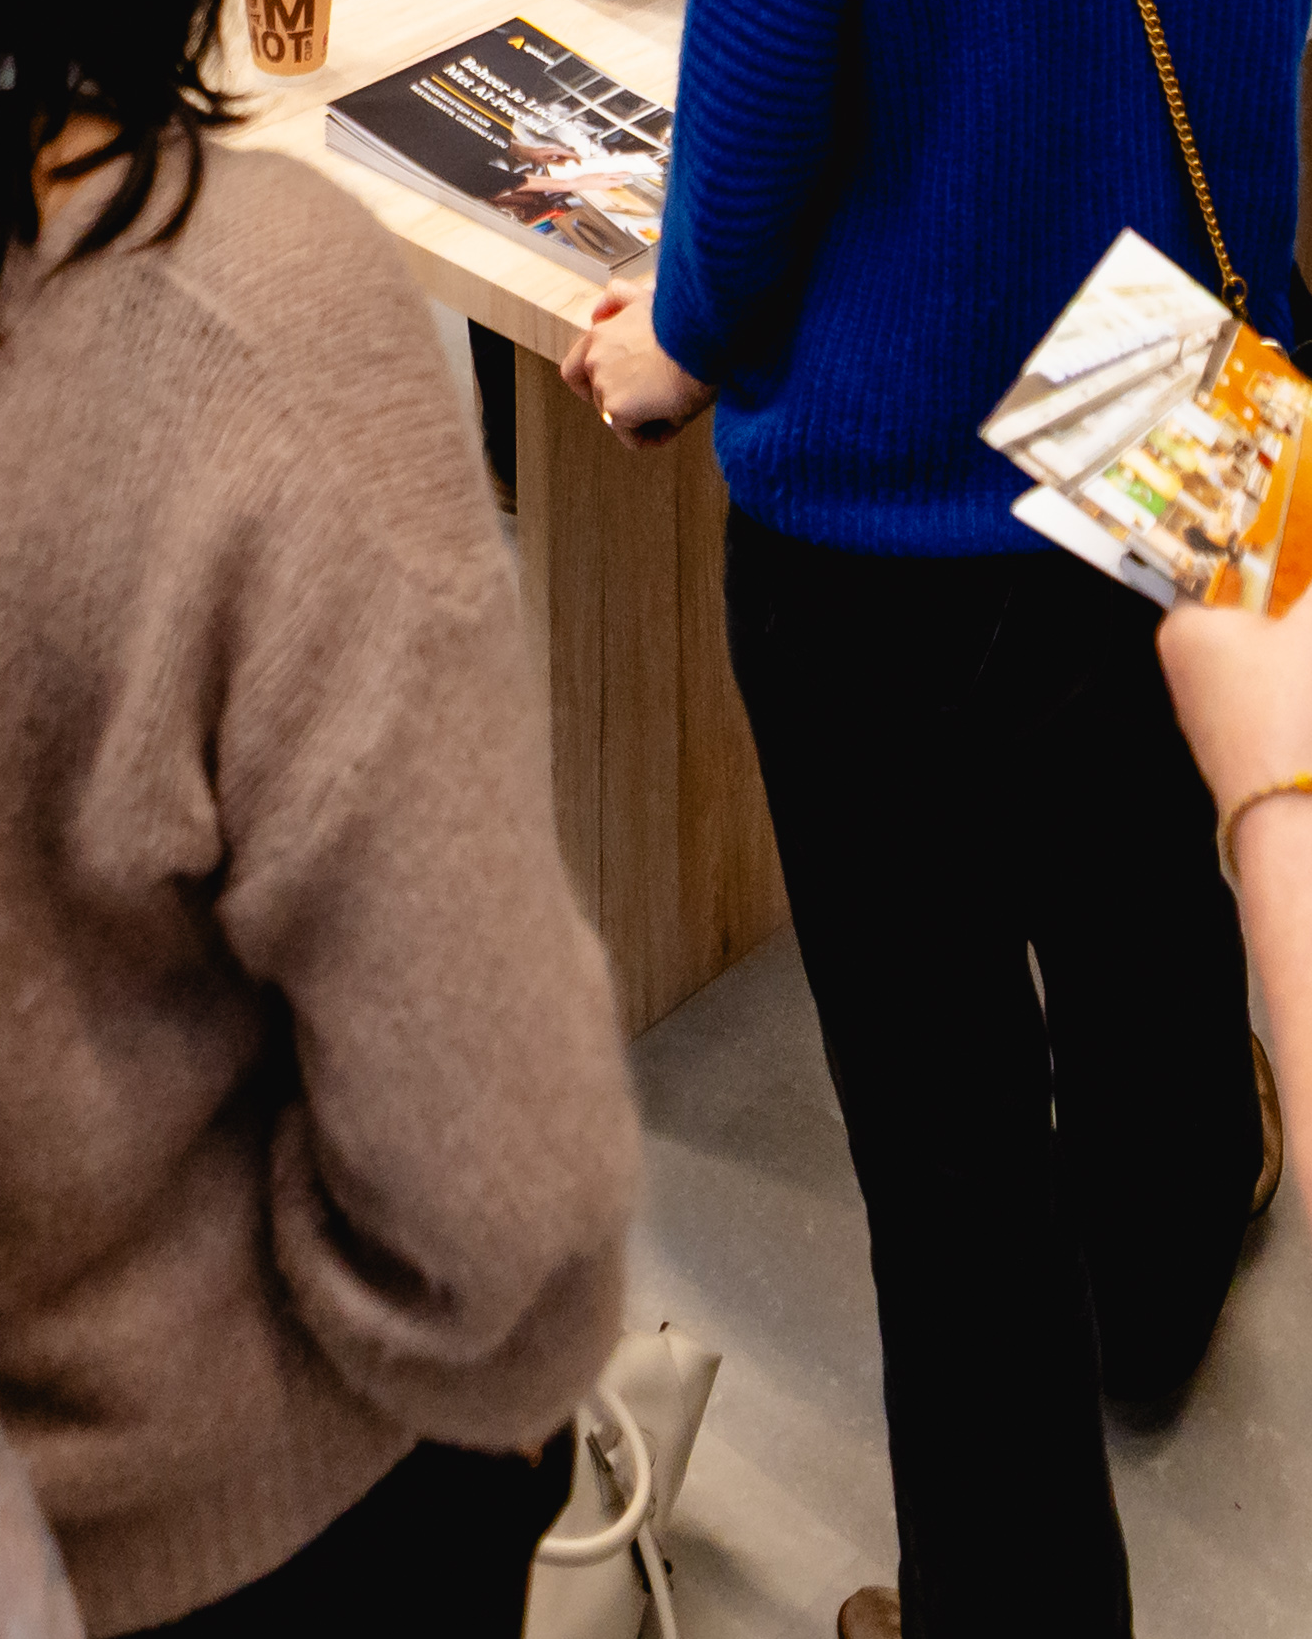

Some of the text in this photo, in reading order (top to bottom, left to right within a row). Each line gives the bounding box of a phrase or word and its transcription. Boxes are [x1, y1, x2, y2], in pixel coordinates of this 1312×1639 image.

[443, 63, 475, 90] Met
[459, 55, 510, 94] Beheer
[507, 88, 527, 104] Je
